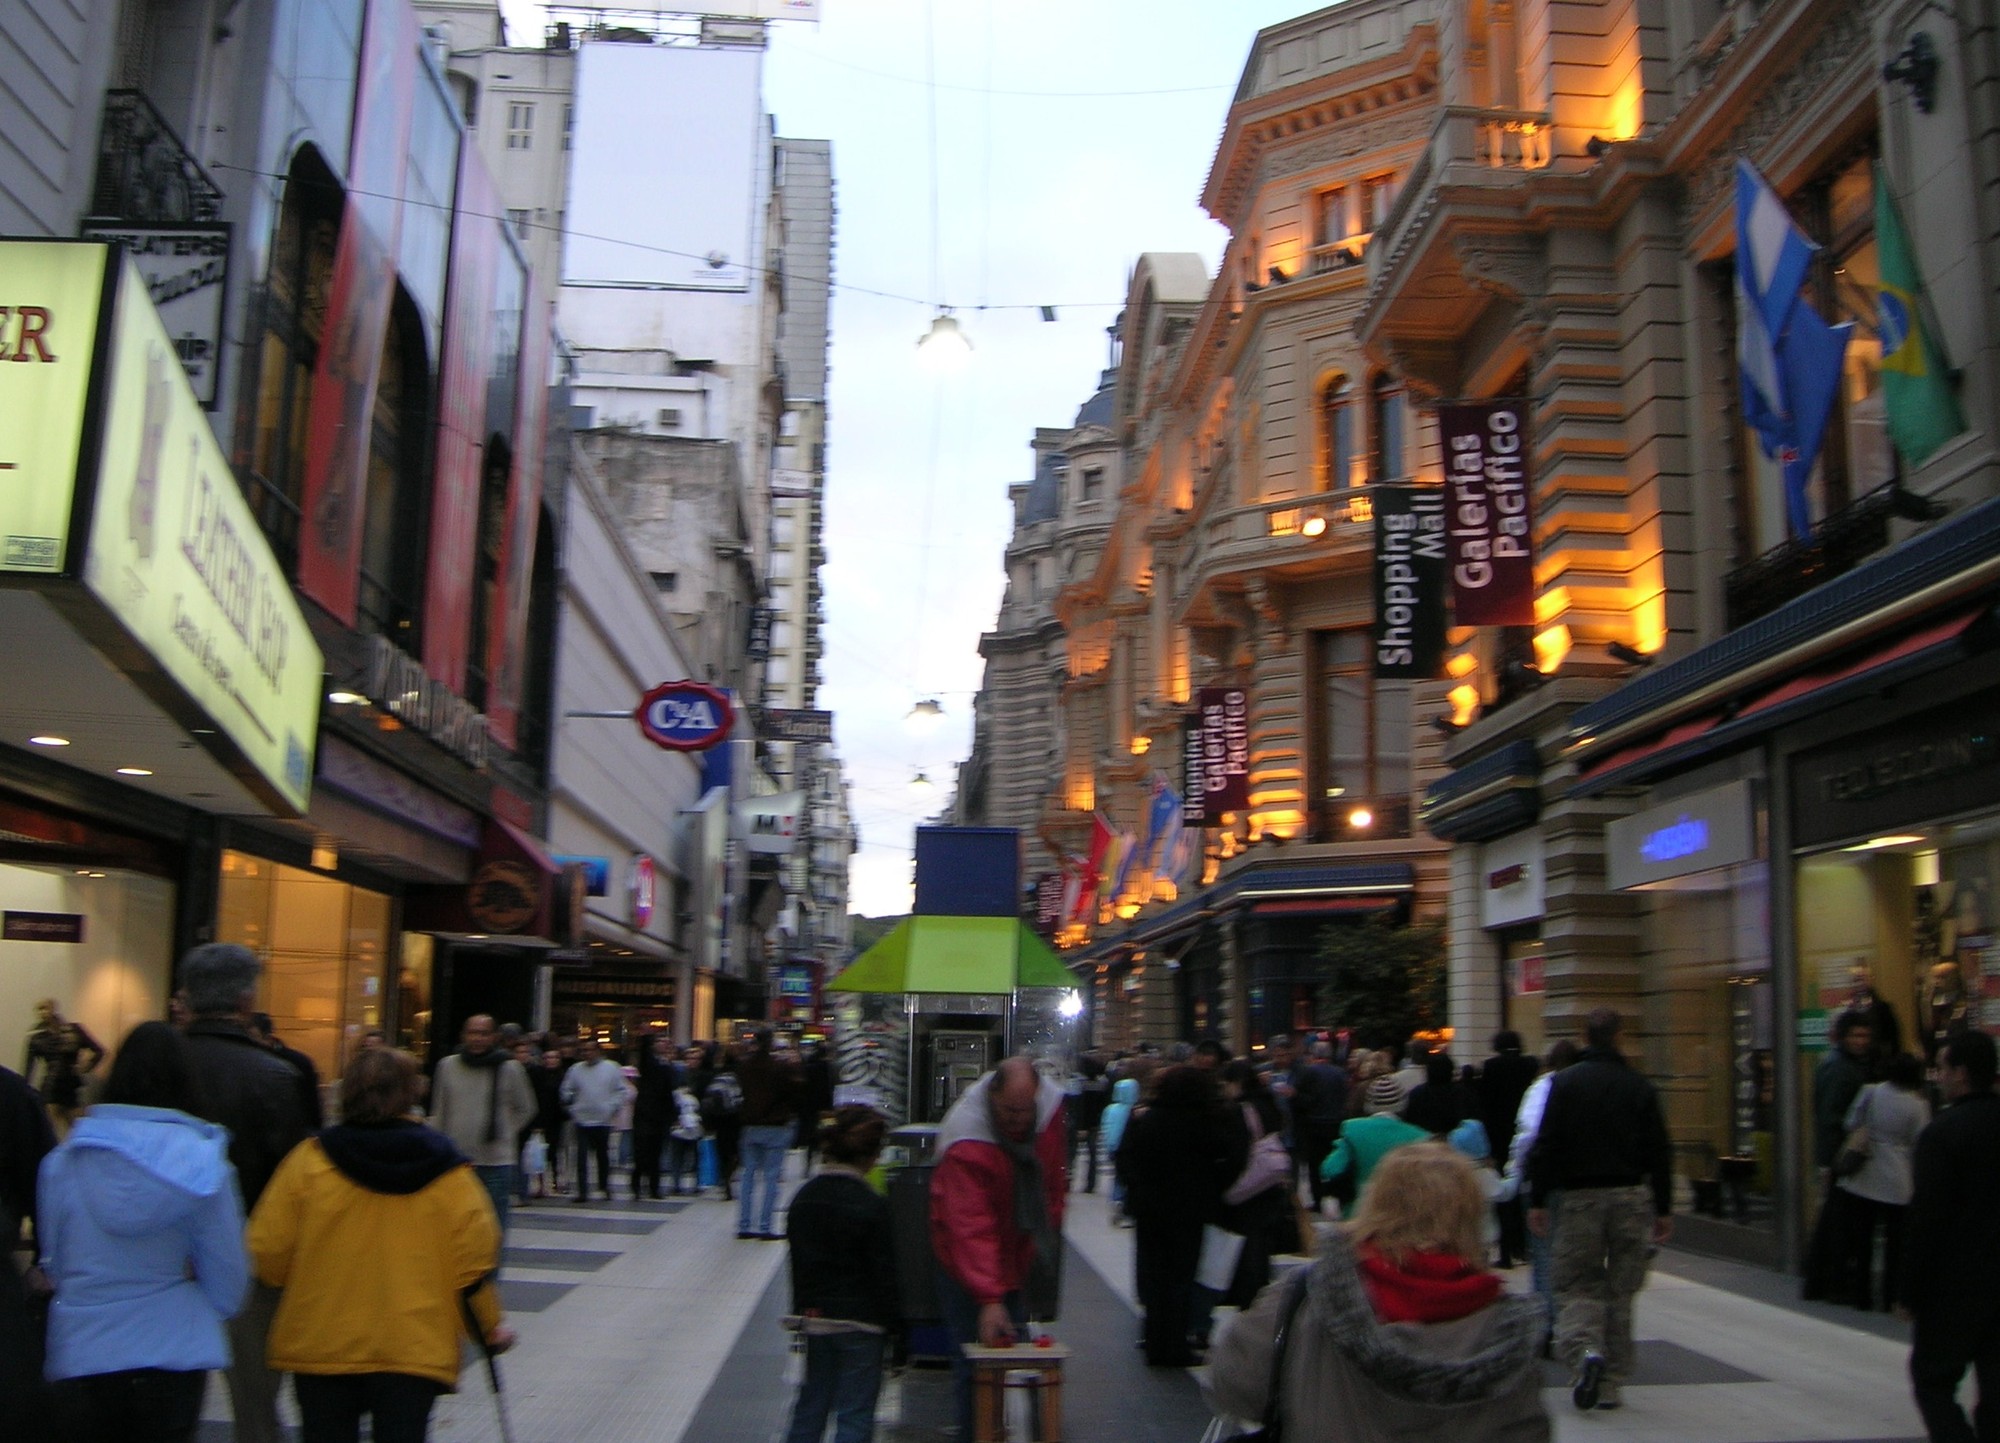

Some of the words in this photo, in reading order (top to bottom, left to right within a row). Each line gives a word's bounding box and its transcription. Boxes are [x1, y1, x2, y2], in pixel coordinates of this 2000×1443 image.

[1409, 492, 1447, 559] Mall
[1377, 512, 1420, 666] Shopping
[647, 699, 720, 730] C&A
